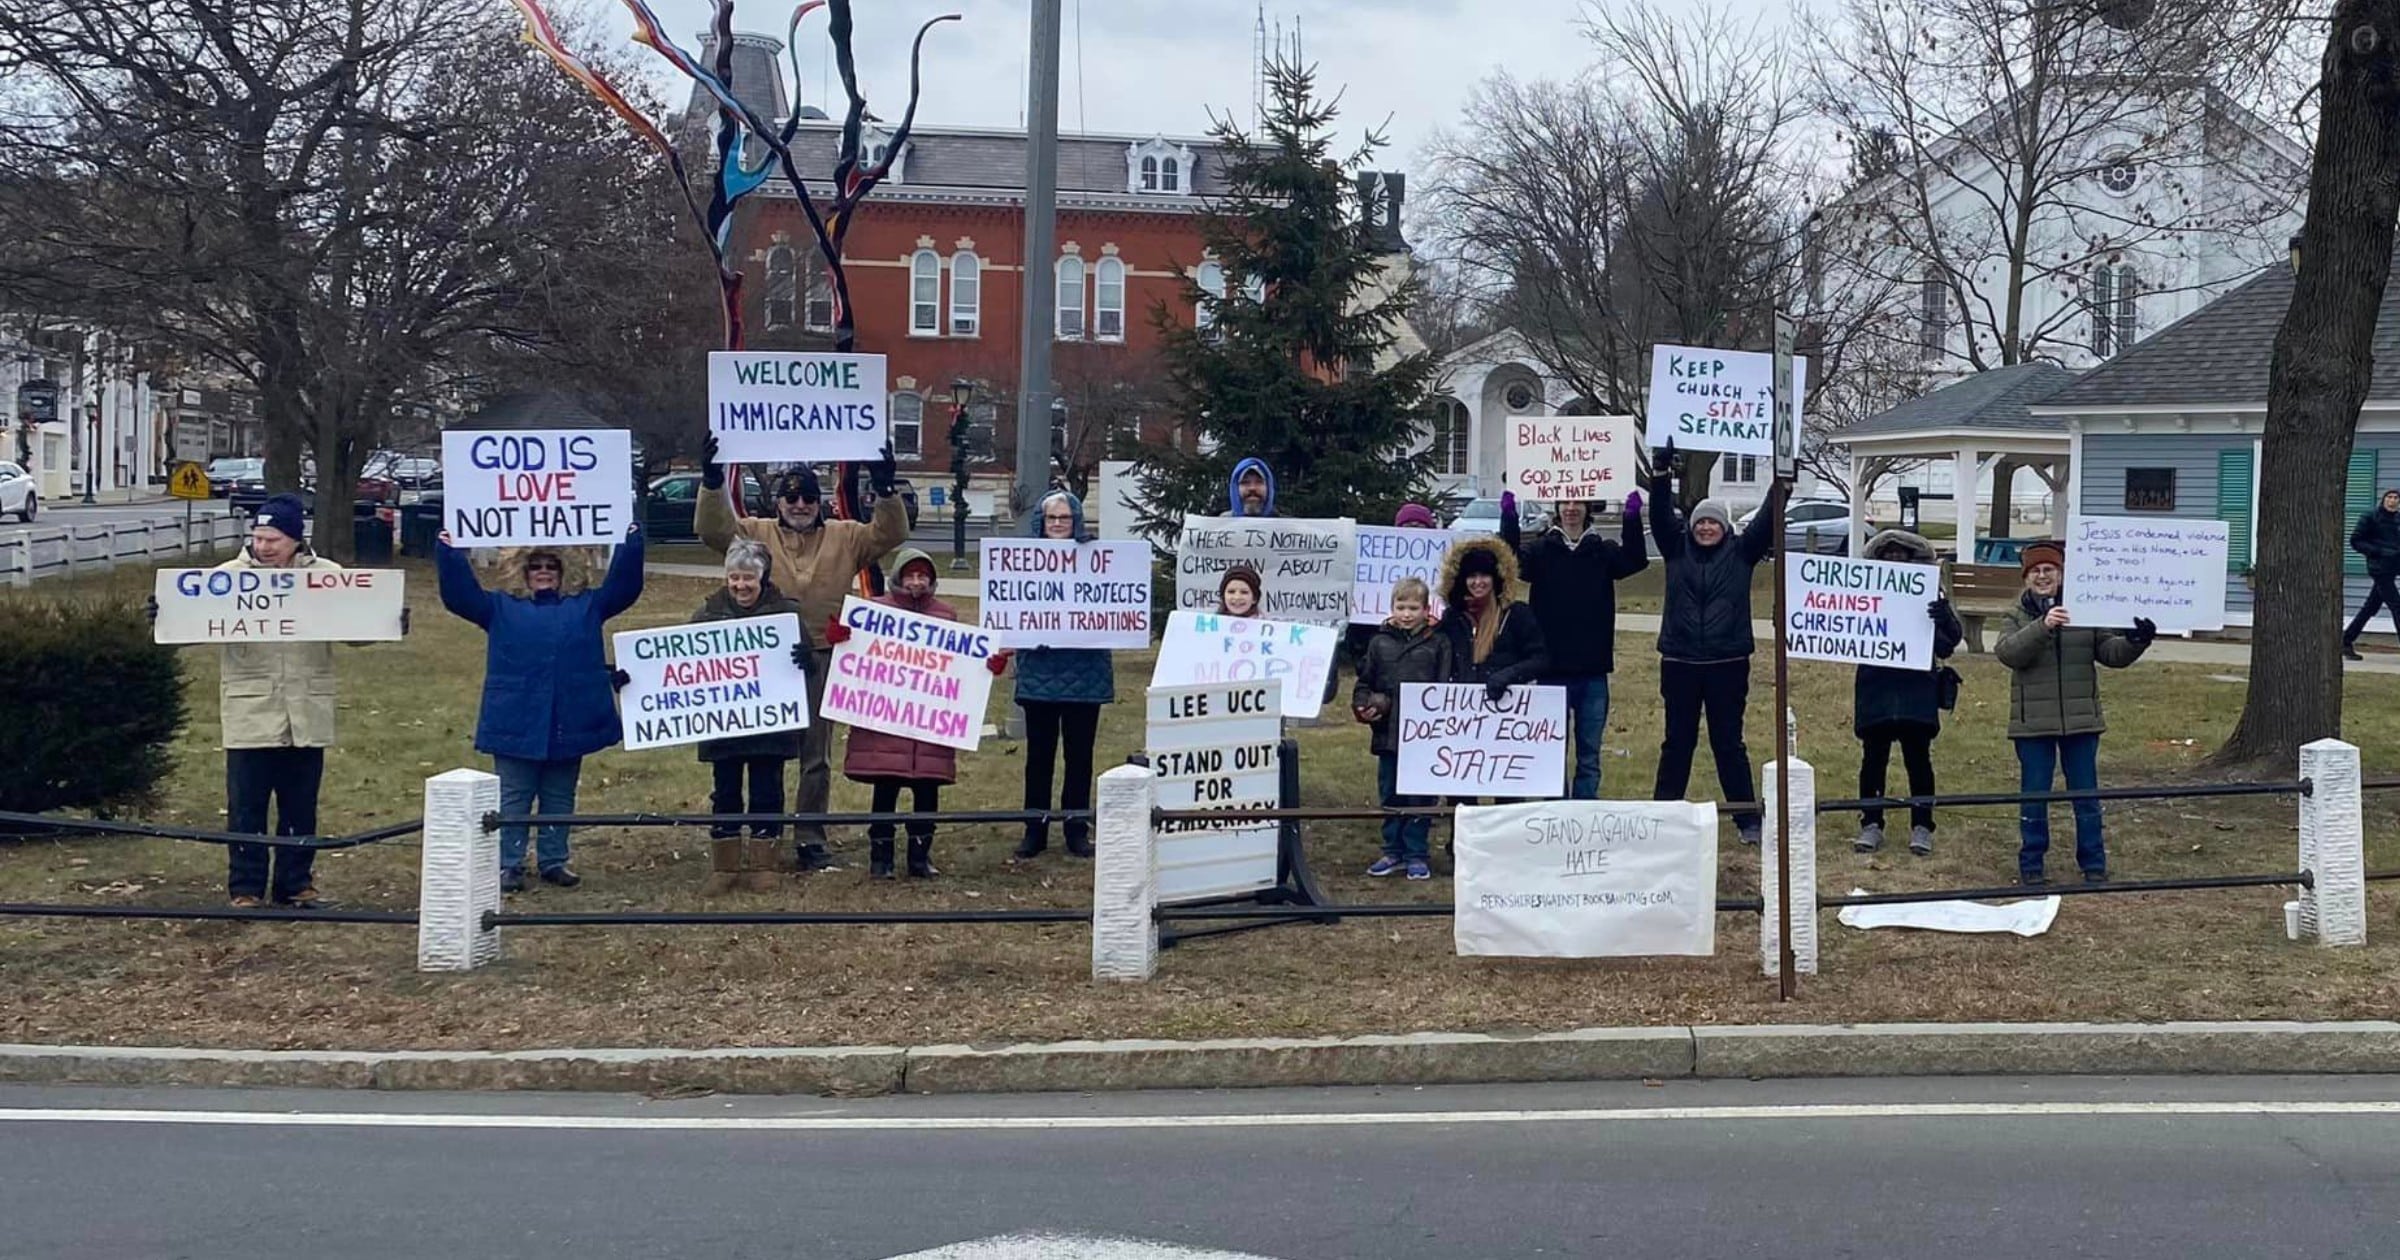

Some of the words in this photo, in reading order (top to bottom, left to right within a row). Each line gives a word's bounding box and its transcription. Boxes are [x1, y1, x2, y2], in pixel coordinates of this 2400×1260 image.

[734, 360, 860, 389] WELCOME
[1670, 353, 1725, 378] KEEP
[1677, 382, 1742, 400] CHURCH
[720, 402, 876, 431] IMMIGRANTS
[1706, 401, 1765, 419] STATE
[1518, 423, 1561, 446] Black
[1572, 426, 1612, 443] Lives
[1679, 413, 1774, 440] SEPARAT
[471, 436, 545, 471] GOD
[560, 436, 597, 470] IS
[1551, 446, 1600, 463] Matter
[498, 472, 576, 501] LOVE
[1520, 468, 1552, 485] GOD
[1557, 470, 1573, 482] IS
[1581, 468, 1612, 481] LOVE
[1538, 486, 1561, 498] NOT
[1566, 485, 1595, 498] HATE
[456, 507, 519, 538] NOT
[530, 504, 613, 537] HATE
[2078, 521, 2121, 541] Jesus
[1187, 528, 1236, 548] THERE
[1244, 529, 1265, 548] IS
[1269, 530, 1338, 549] NOTHING
[1356, 534, 1446, 560] REEDOM
[989, 547, 1077, 574] FREEDOM
[1090, 549, 1114, 574] OF
[1277, 559, 1334, 577] ABOUT
[177, 571, 260, 596] GOD
[271, 573, 294, 589] IS
[306, 572, 373, 588] LOVE
[1800, 559, 1926, 595] CHRISTIANS
[237, 594, 291, 610] NOT
[988, 580, 1065, 601] RELIGION
[1074, 582, 1147, 604] PROTECTS
[1266, 590, 1349, 617] NATIONALISM
[1804, 590, 1883, 613] AGAINST
[208, 619, 296, 636] HATE
[848, 606, 989, 658] CHRISTIANS
[984, 611, 1013, 630] ALL
[1019, 611, 1061, 630] FAITH
[1068, 610, 1148, 632] TRADITIONS
[1791, 612, 1887, 637] CHRISTIAN
[635, 625, 780, 660] CHRISTIANS
[866, 638, 954, 672] AGAINST
[1785, 633, 1906, 662] NATIONALISM
[663, 655, 760, 687] AGAINST
[839, 653, 961, 700] CHRISTIAN
[641, 680, 761, 712] CHRISTIAN
[1169, 694, 1208, 718] LEE
[1228, 689, 1266, 713] UCC
[1421, 685, 1532, 716] CHURCH
[636, 701, 800, 743] NATIONALISM
[828, 684, 969, 738] NATIONALISM
[1495, 718, 1564, 744] EQUAL
[1156, 749, 1222, 777] STAND
[1234, 745, 1272, 770] OUT
[1430, 746, 1535, 784] STATE
[1194, 777, 1233, 802] FOR
[1525, 817, 1583, 844] STAND
[1588, 814, 1664, 842] AGAINST
[1566, 849, 1610, 873] HATE
